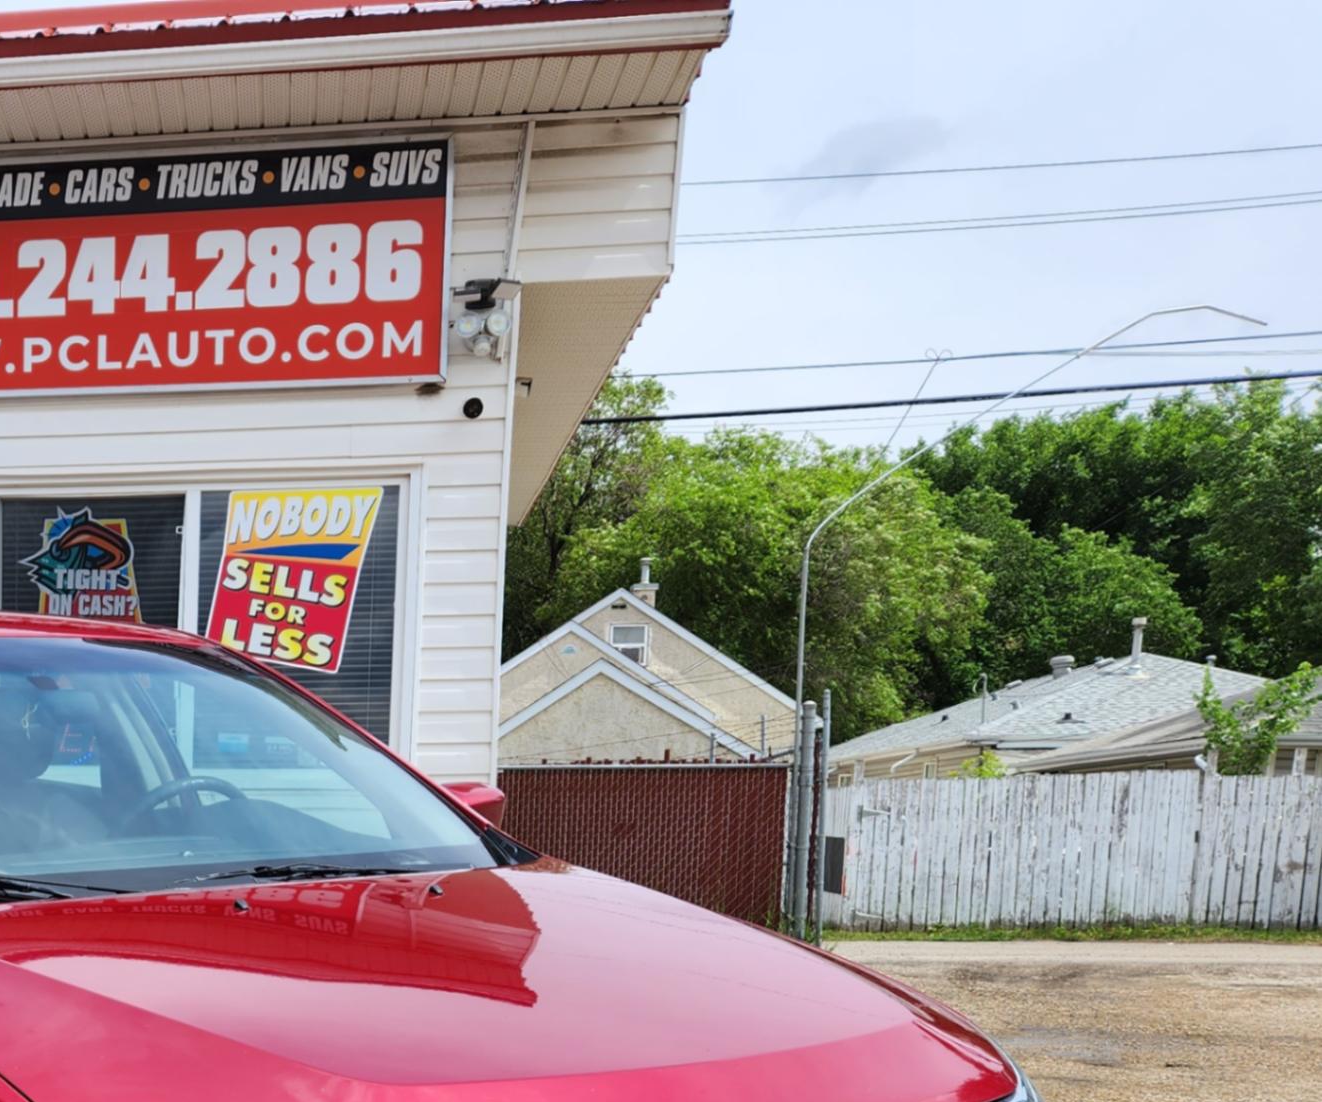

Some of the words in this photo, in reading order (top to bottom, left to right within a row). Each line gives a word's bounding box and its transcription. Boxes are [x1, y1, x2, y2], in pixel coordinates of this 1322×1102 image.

[65, 166, 134, 204] CARS
[156, 160, 259, 199] TRUCKS
[280, 154, 349, 192] VANS
[369, 149, 442, 188] SUVS
[228, 495, 377, 544] NOBODY
[54, 569, 120, 590] TIGHT
[221, 557, 348, 607] SELLS
[48, 593, 73, 616] ON
[79, 594, 138, 616] CASH?
[248, 599, 307, 625] FOR
[221, 617, 333, 666] LESS
